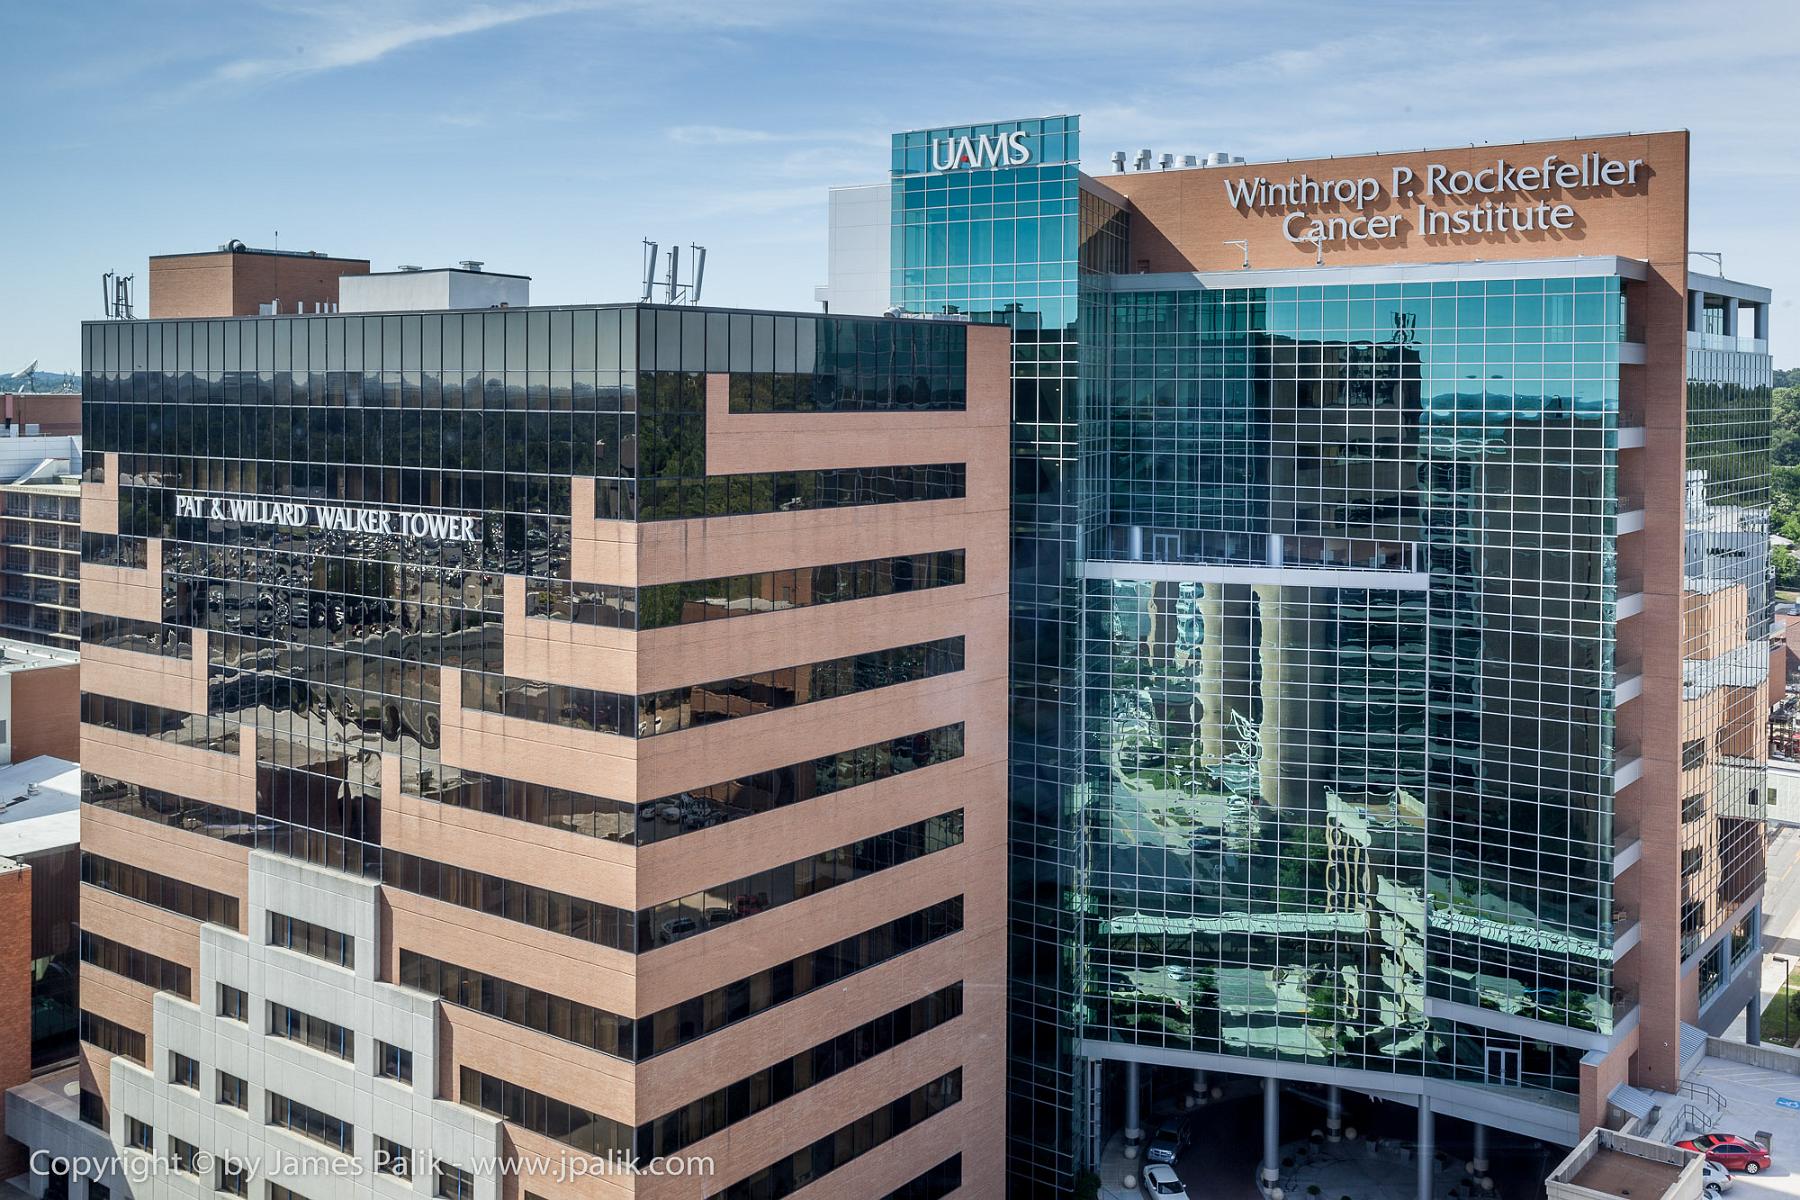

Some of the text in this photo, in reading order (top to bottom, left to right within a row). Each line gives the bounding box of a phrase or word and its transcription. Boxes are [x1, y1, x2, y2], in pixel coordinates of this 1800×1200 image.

[933, 131, 1030, 170] UAMS
[1224, 152, 1644, 210] Winthrop P. Rockefeller
[1283, 200, 1575, 244] Cancer Institute
[175, 495, 476, 541] PAT & WILLARD WALKER TOWER
